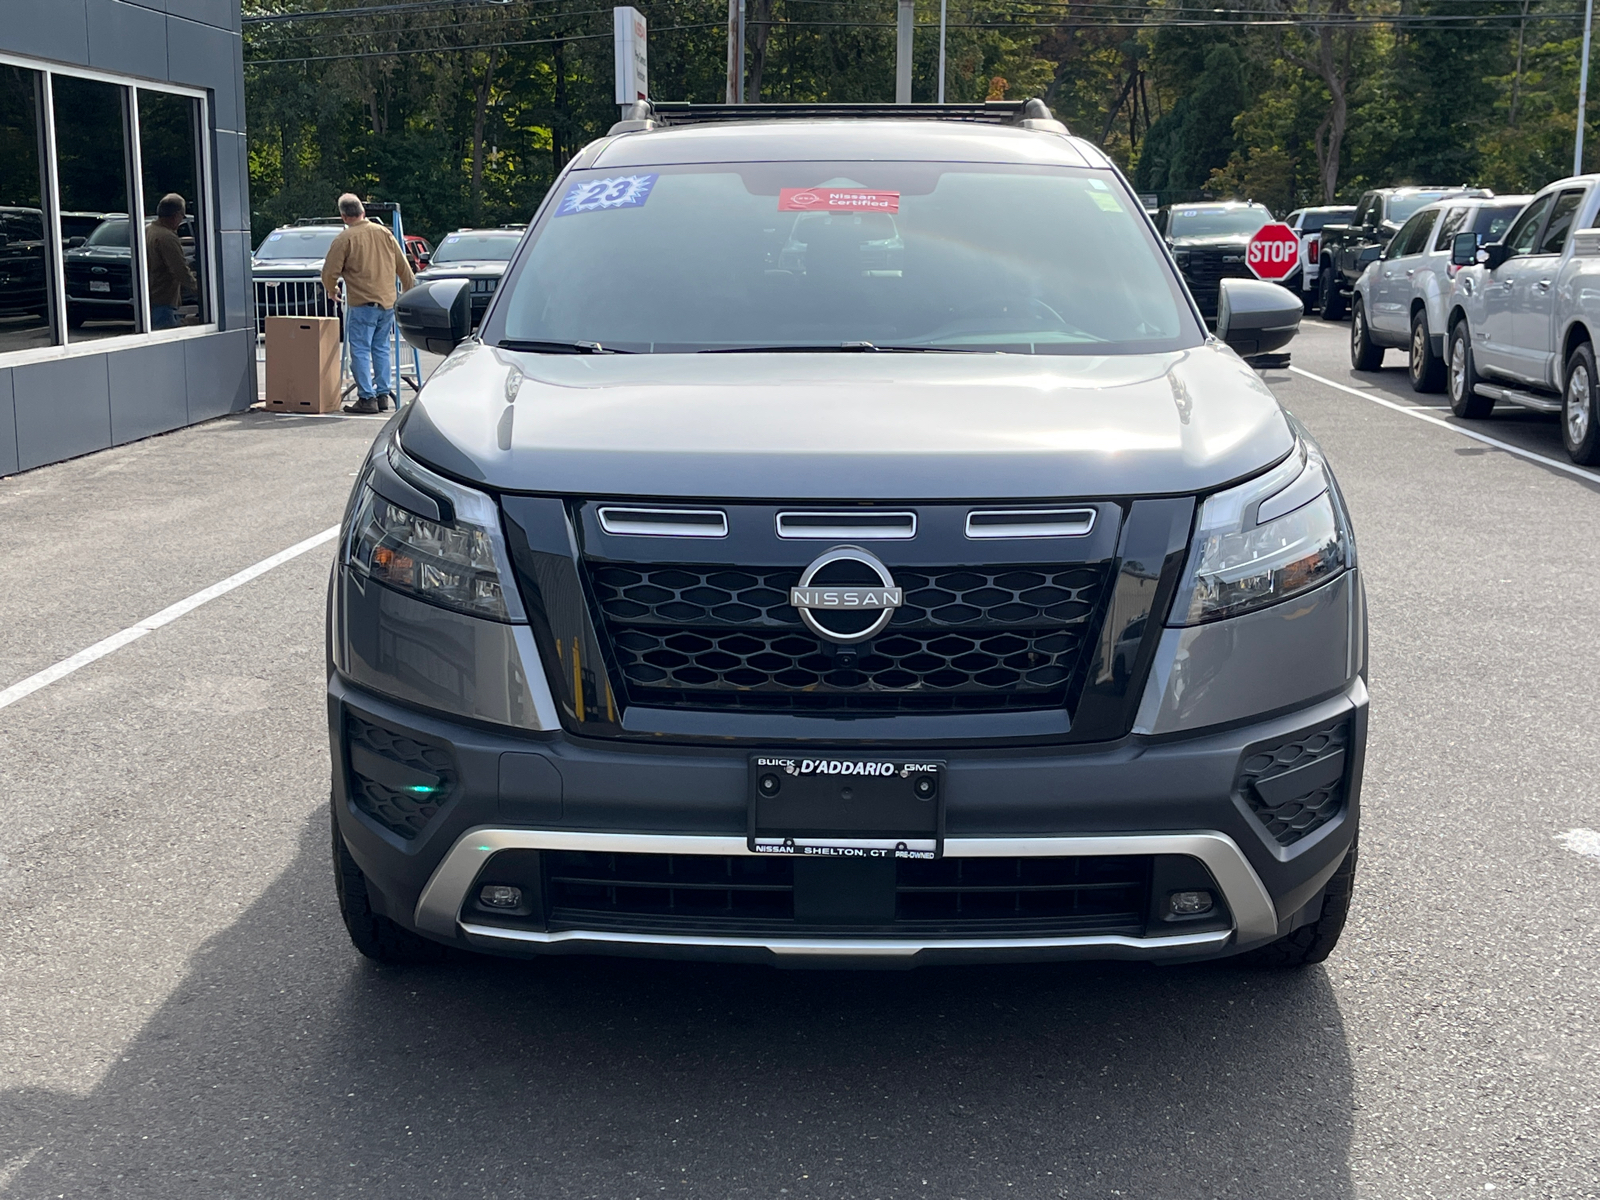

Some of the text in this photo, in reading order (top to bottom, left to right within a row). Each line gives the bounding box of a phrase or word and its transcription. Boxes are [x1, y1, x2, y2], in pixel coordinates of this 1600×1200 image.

[580, 181, 632, 204] 23
[829, 193, 876, 201] Nissan
[828, 199, 889, 207] Certified
[1250, 241, 1296, 263] STOP
[794, 592, 898, 605] NISSAN
[801, 760, 894, 776] D'ADDARIO
[904, 764, 937, 772] GMC
[756, 845, 794, 853] NISSAN
[804, 847, 867, 857] SHELTON,
[895, 851, 934, 859] PRE-OWNED
